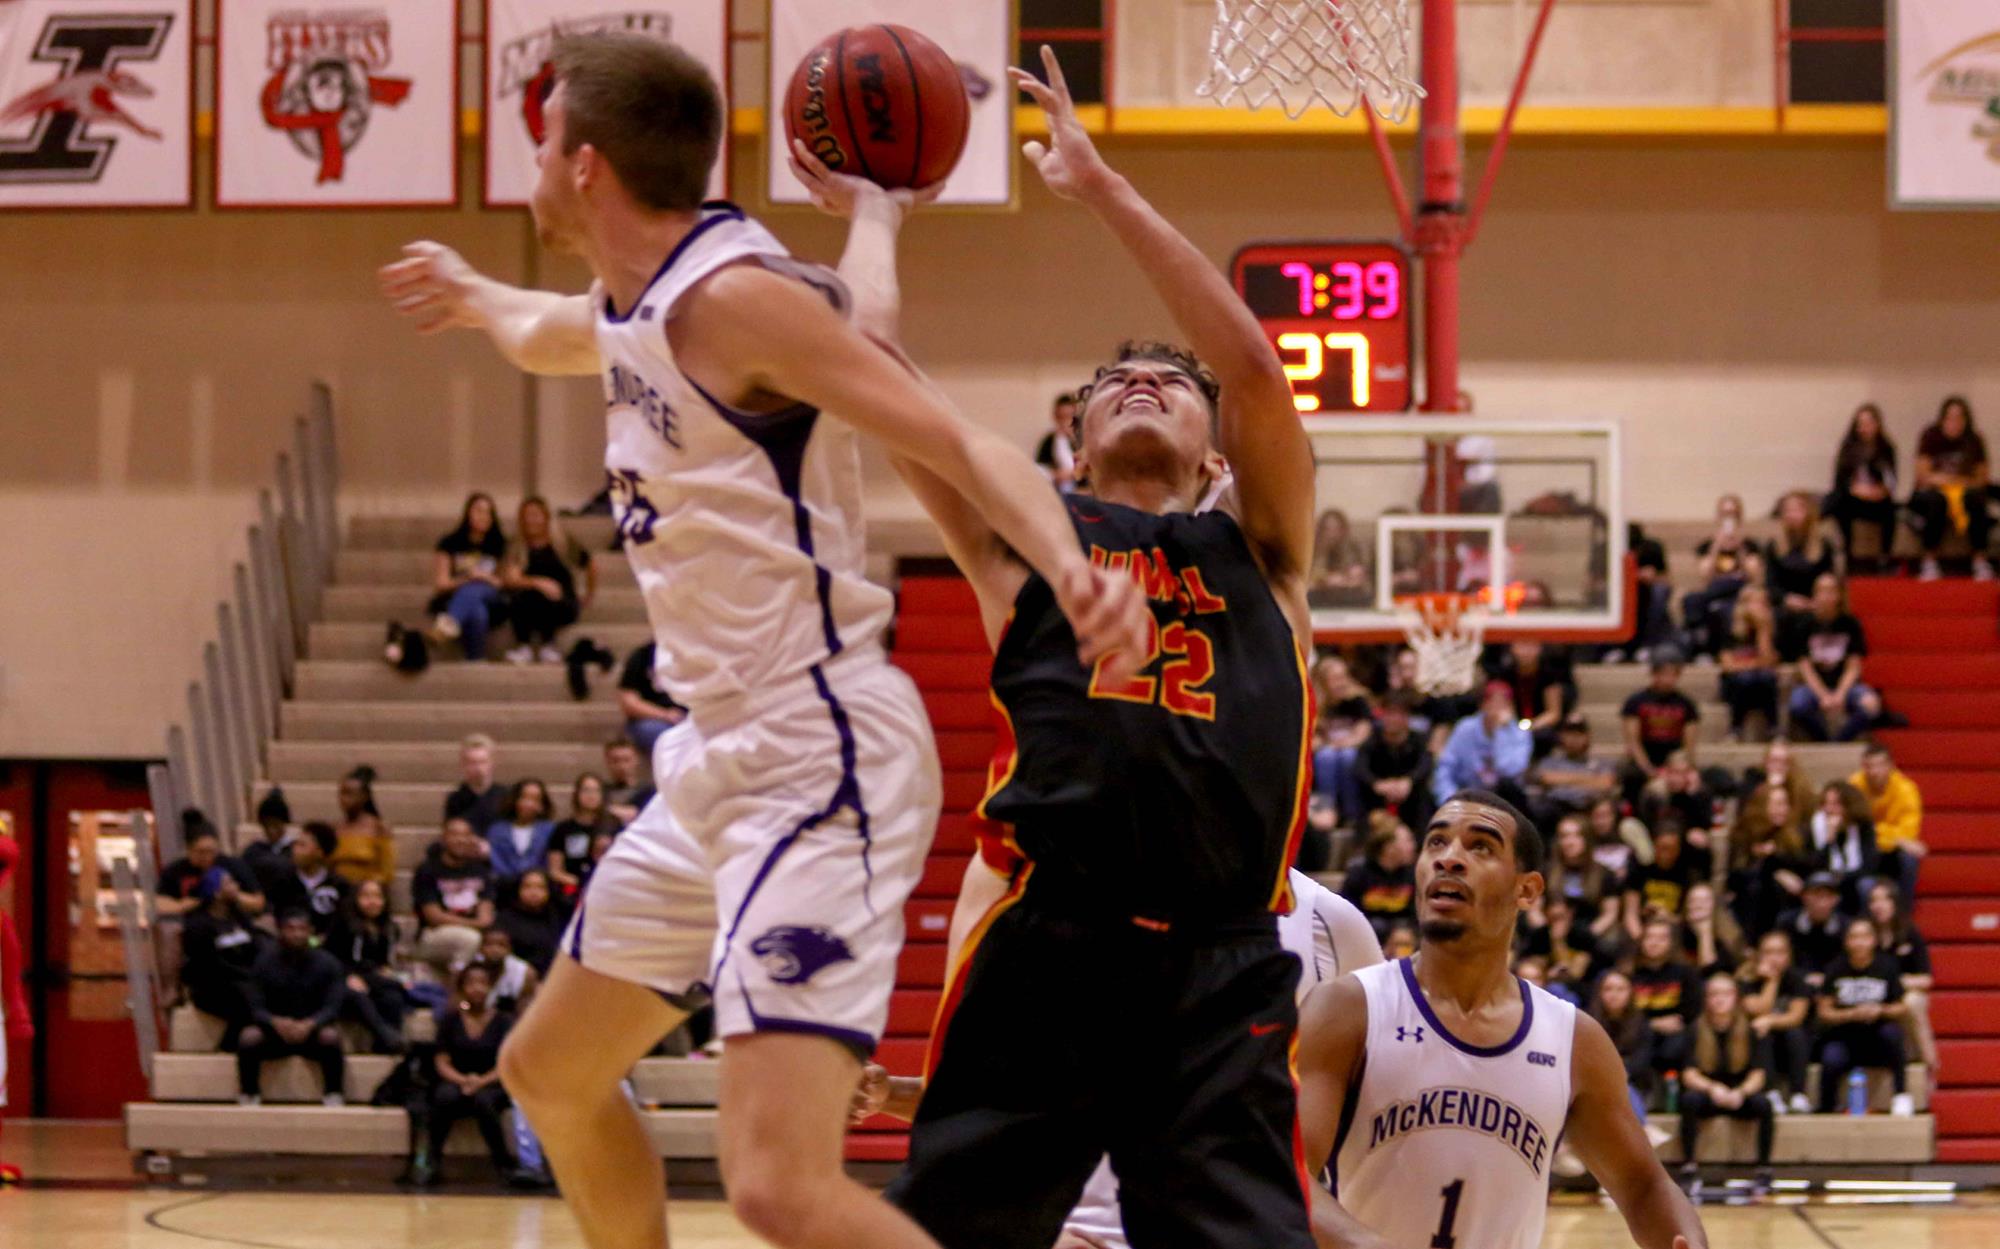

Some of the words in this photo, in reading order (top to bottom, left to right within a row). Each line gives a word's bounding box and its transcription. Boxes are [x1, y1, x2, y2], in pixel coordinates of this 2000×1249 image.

[803, 51, 848, 171] Wilson
[855, 54, 898, 143] NCAA
[1280, 262, 1400, 319] 7:39
[1278, 332, 1370, 412] 27
[1429, 1178, 1465, 1249] 1
